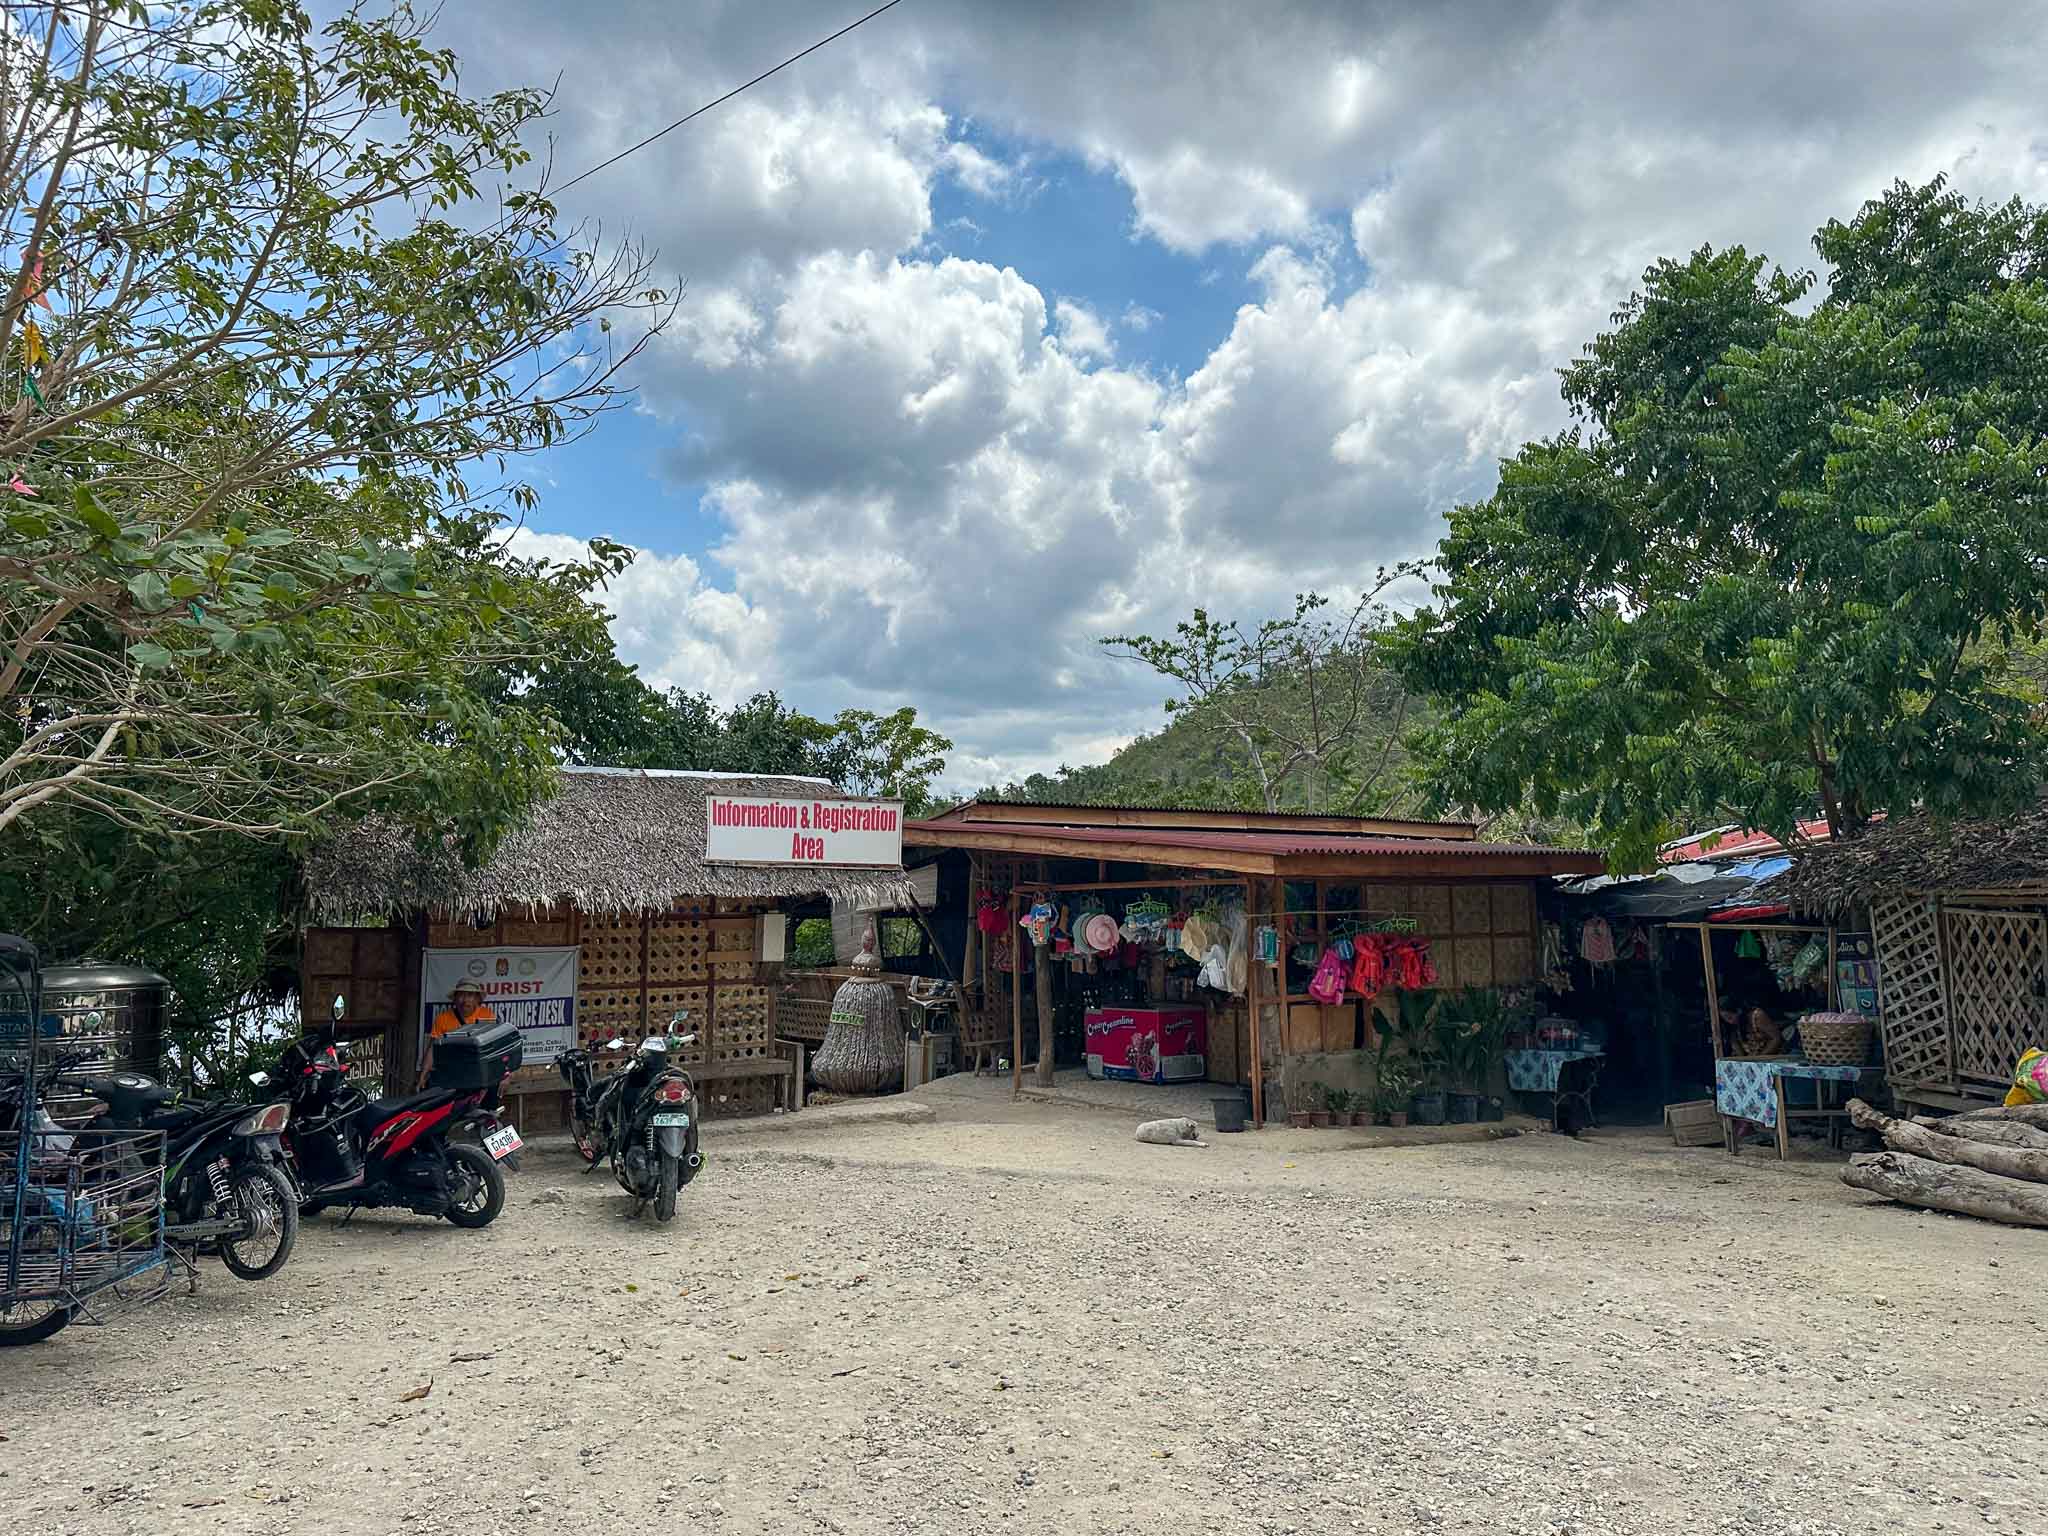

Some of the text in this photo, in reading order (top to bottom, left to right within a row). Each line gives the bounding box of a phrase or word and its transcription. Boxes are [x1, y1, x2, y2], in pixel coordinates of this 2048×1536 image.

[712, 799, 897, 833] Information & Registration
[791, 832, 824, 860] Area
[480, 980, 544, 995] URIST
[538, 999, 566, 1026] DESK
